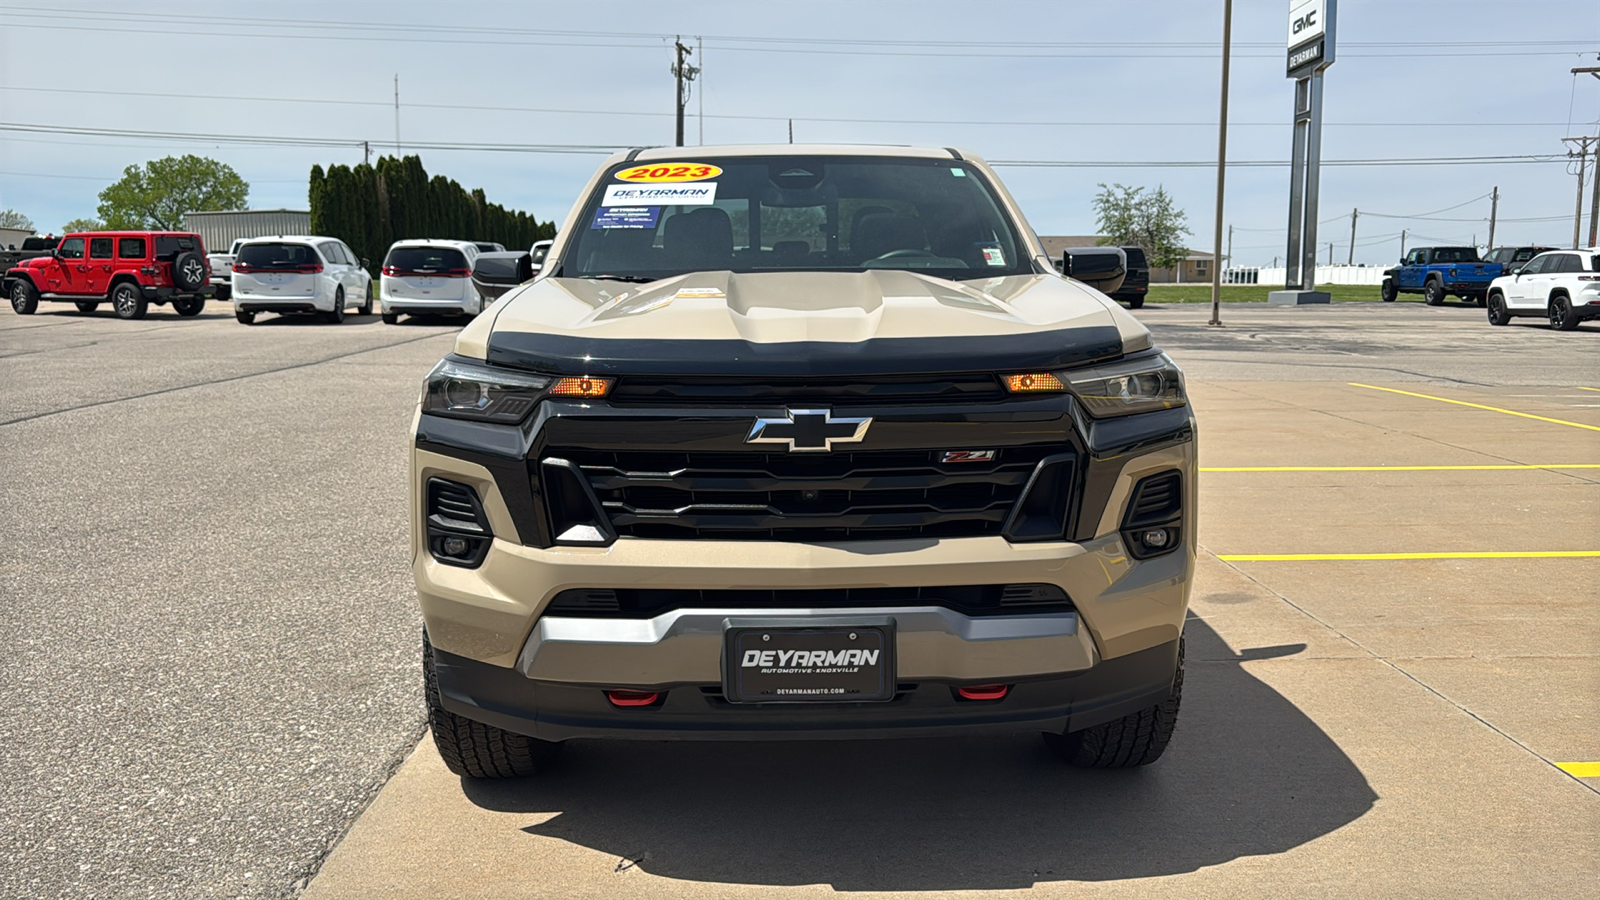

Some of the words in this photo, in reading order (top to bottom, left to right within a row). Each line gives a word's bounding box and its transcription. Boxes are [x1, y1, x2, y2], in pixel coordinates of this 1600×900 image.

[1293, 9, 1317, 35] GMC
[626, 167, 712, 179] 2023
[613, 189, 709, 197] DEYARMAN
[942, 451, 995, 462] Z71
[741, 649, 879, 667] DEYARMAN
